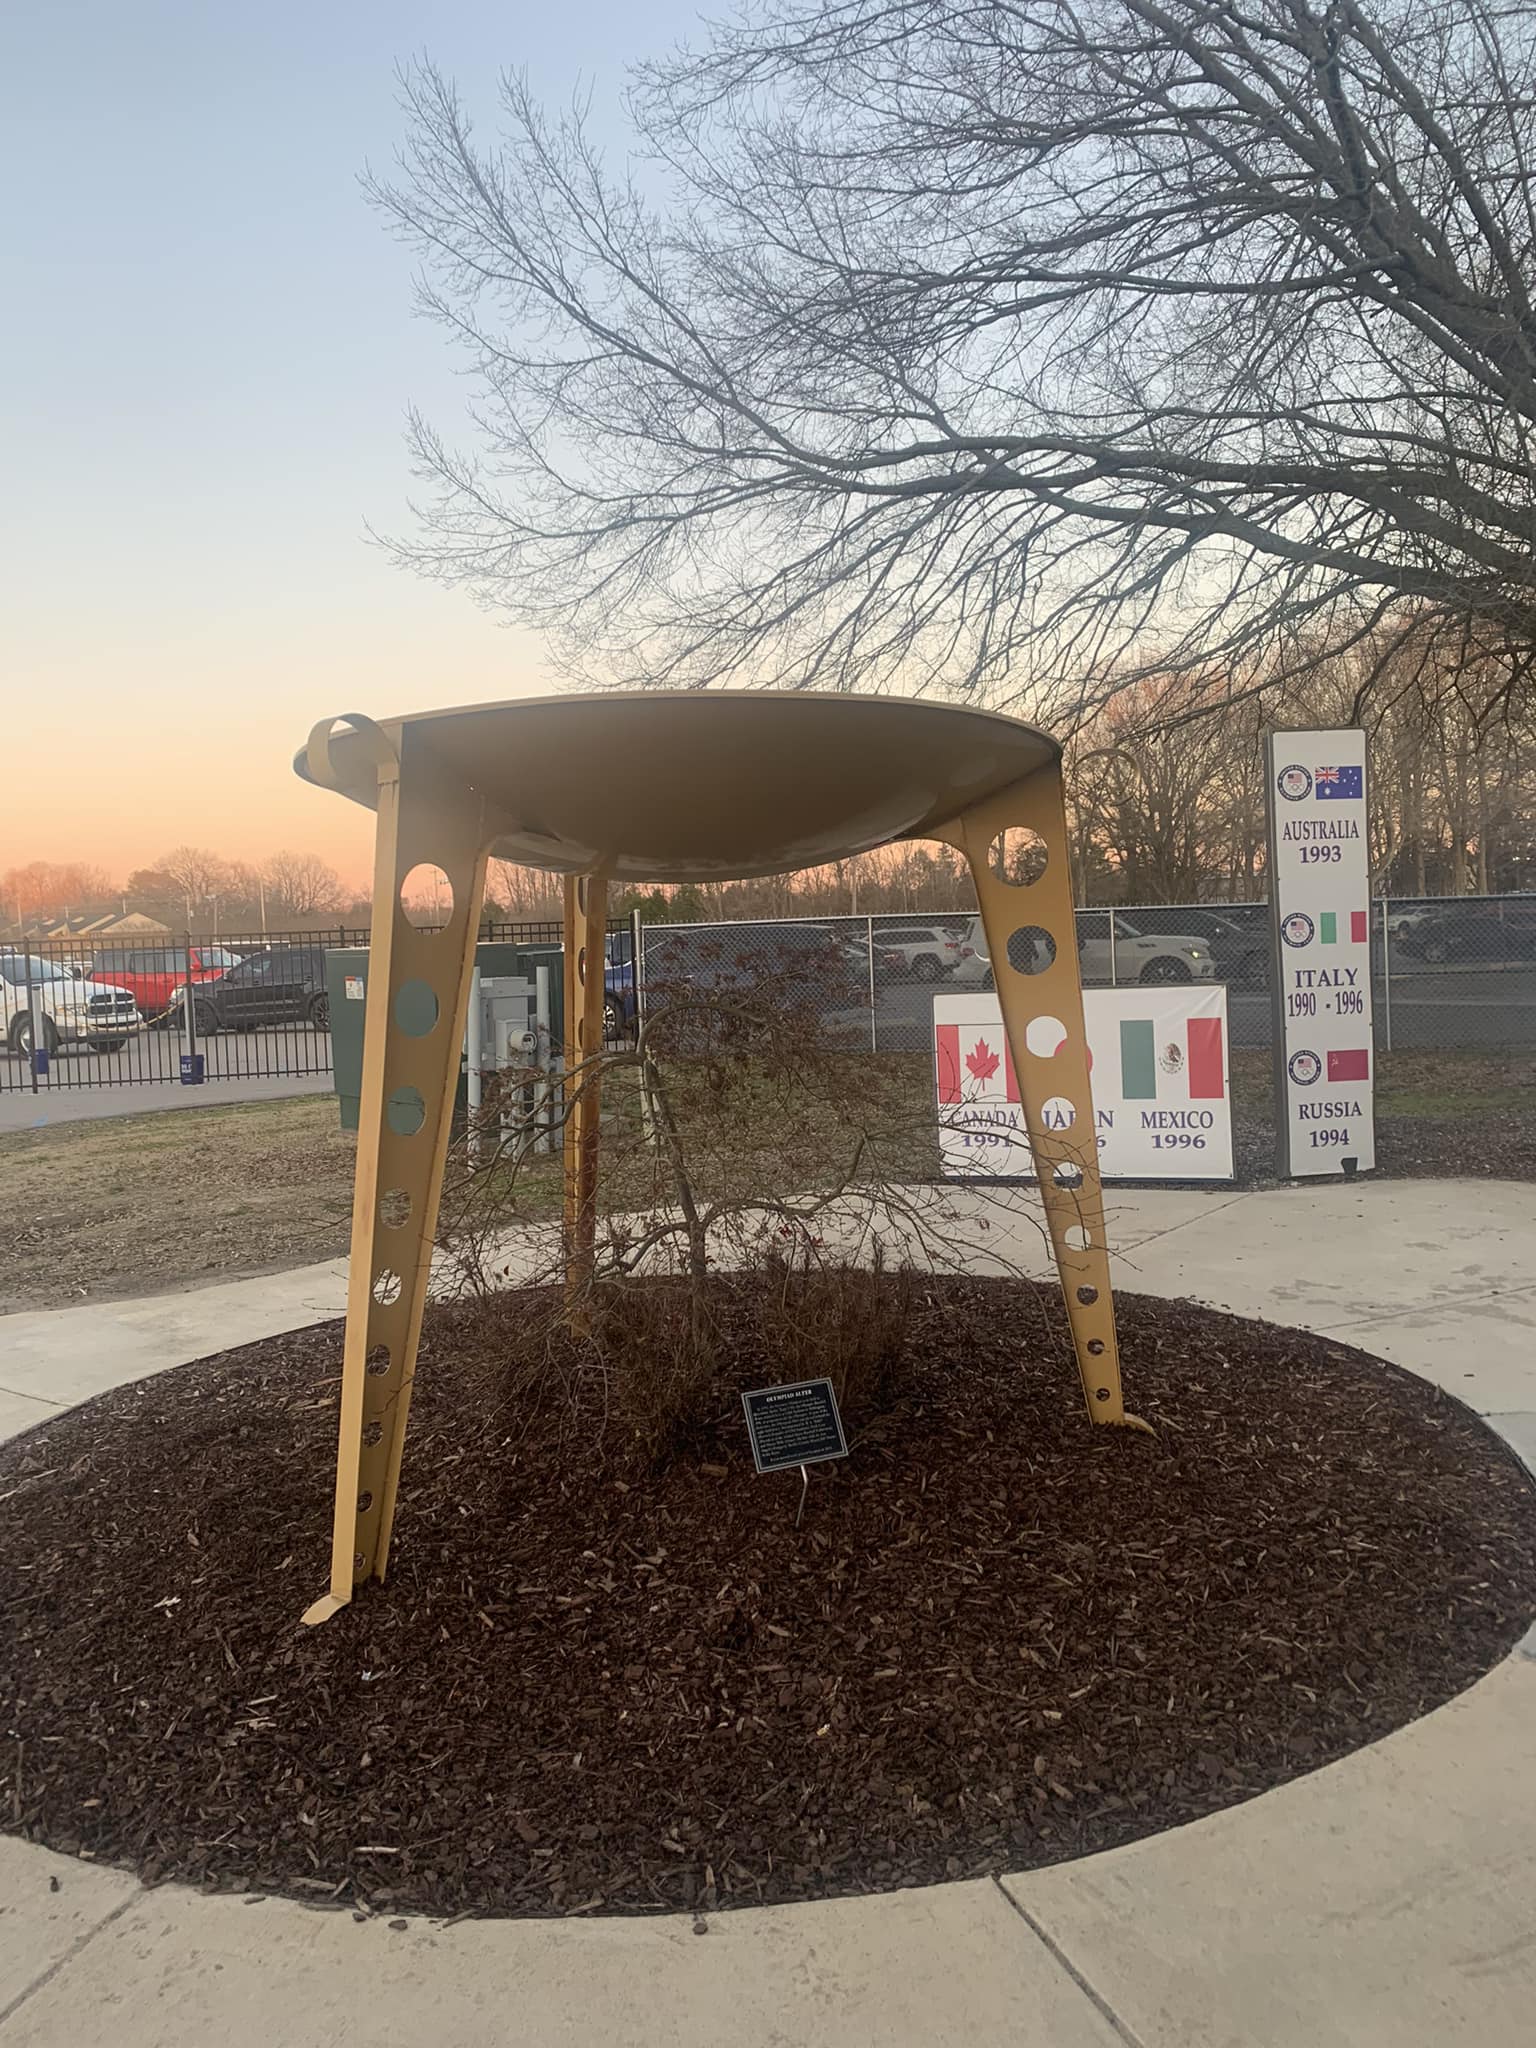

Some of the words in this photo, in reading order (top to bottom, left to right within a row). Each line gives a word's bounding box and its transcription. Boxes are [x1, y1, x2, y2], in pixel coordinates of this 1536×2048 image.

[1283, 820, 1359, 840] AUSTRALIA
[1299, 845, 1342, 863] 1993
[1295, 968, 1358, 988] ITALY
[1288, 992, 1316, 1016] 1990
[1335, 990, 1363, 1014] 1996
[1298, 1101, 1362, 1119] RUSSIA
[1141, 1111, 1213, 1128] MEXICO
[1151, 1134, 1206, 1149] 1996
[1309, 1128, 1350, 1147] 1994
